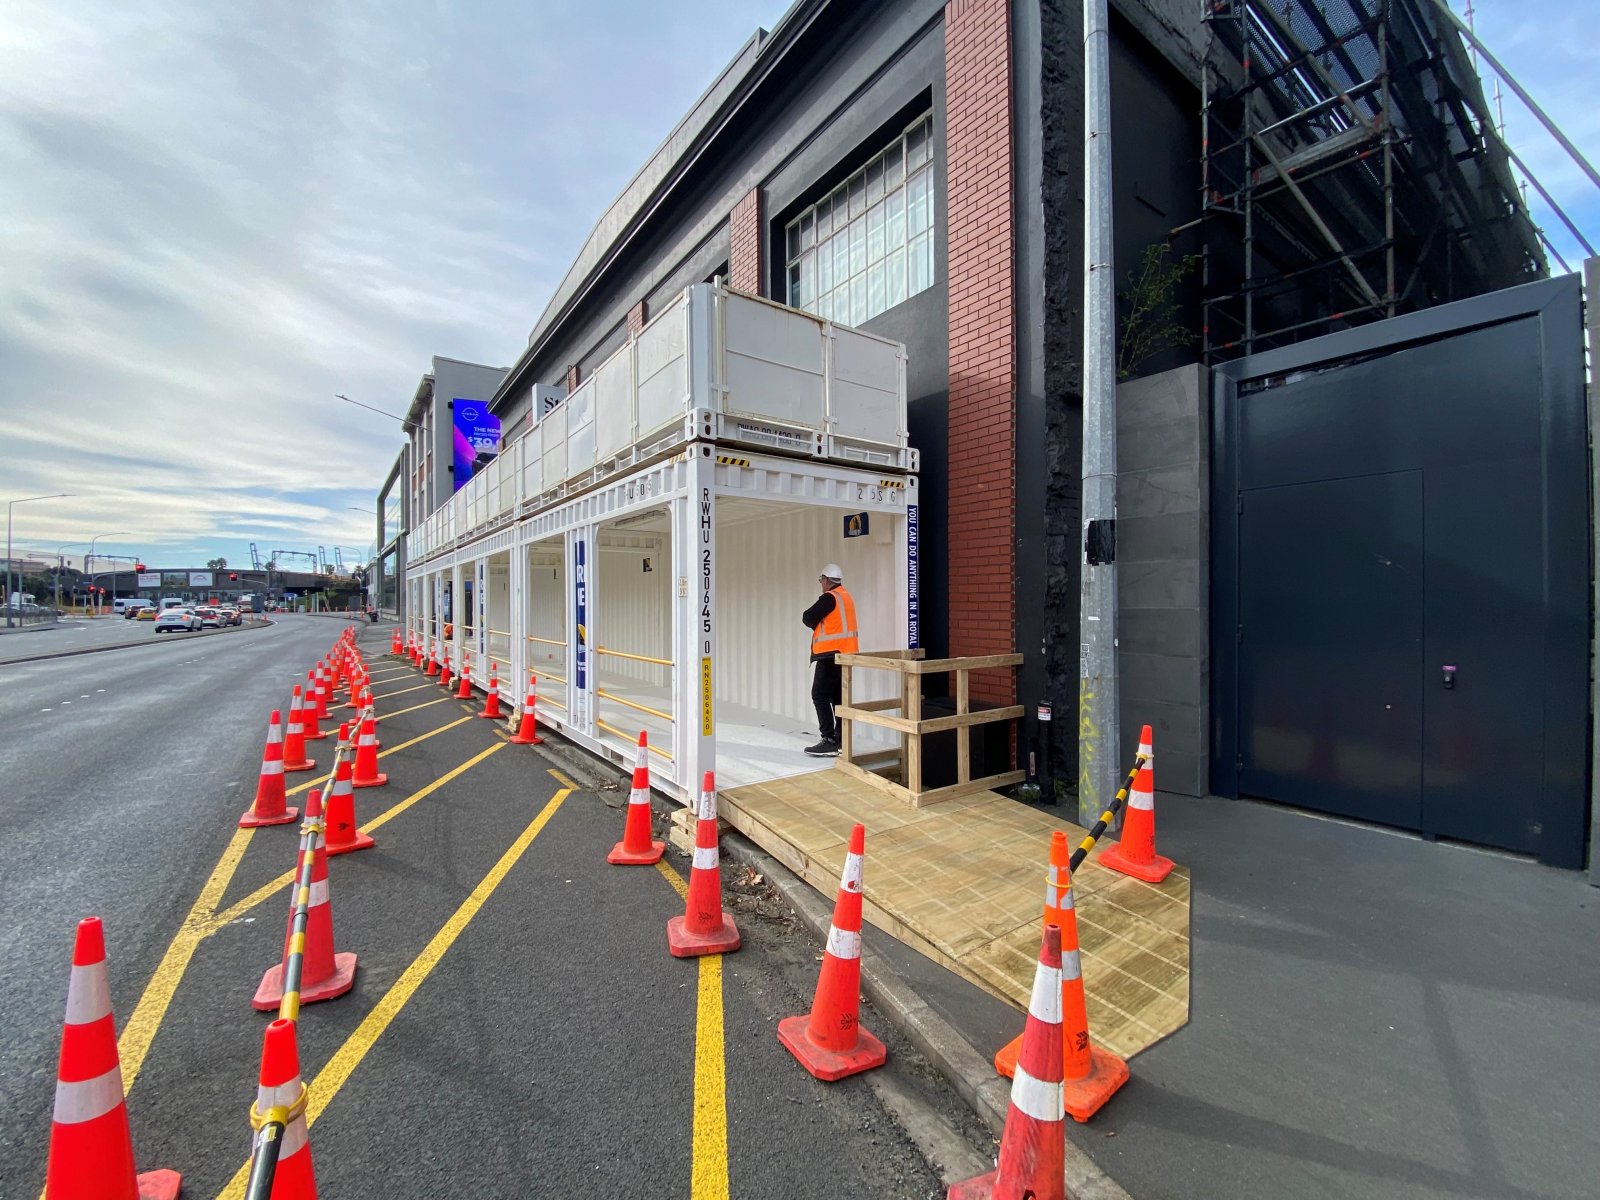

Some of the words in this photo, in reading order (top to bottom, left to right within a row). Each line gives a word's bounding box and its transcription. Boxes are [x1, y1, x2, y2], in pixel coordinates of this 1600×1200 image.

[701, 487, 711, 543] RWHU
[908, 507, 917, 524] YOU
[908, 526, 917, 542] CAN
[908, 545, 917, 557] DO
[908, 559, 918, 599] ANYTHING
[702, 549, 711, 633] 250645
[909, 601, 917, 610] IN
[909, 621, 918, 645] ROYAL
